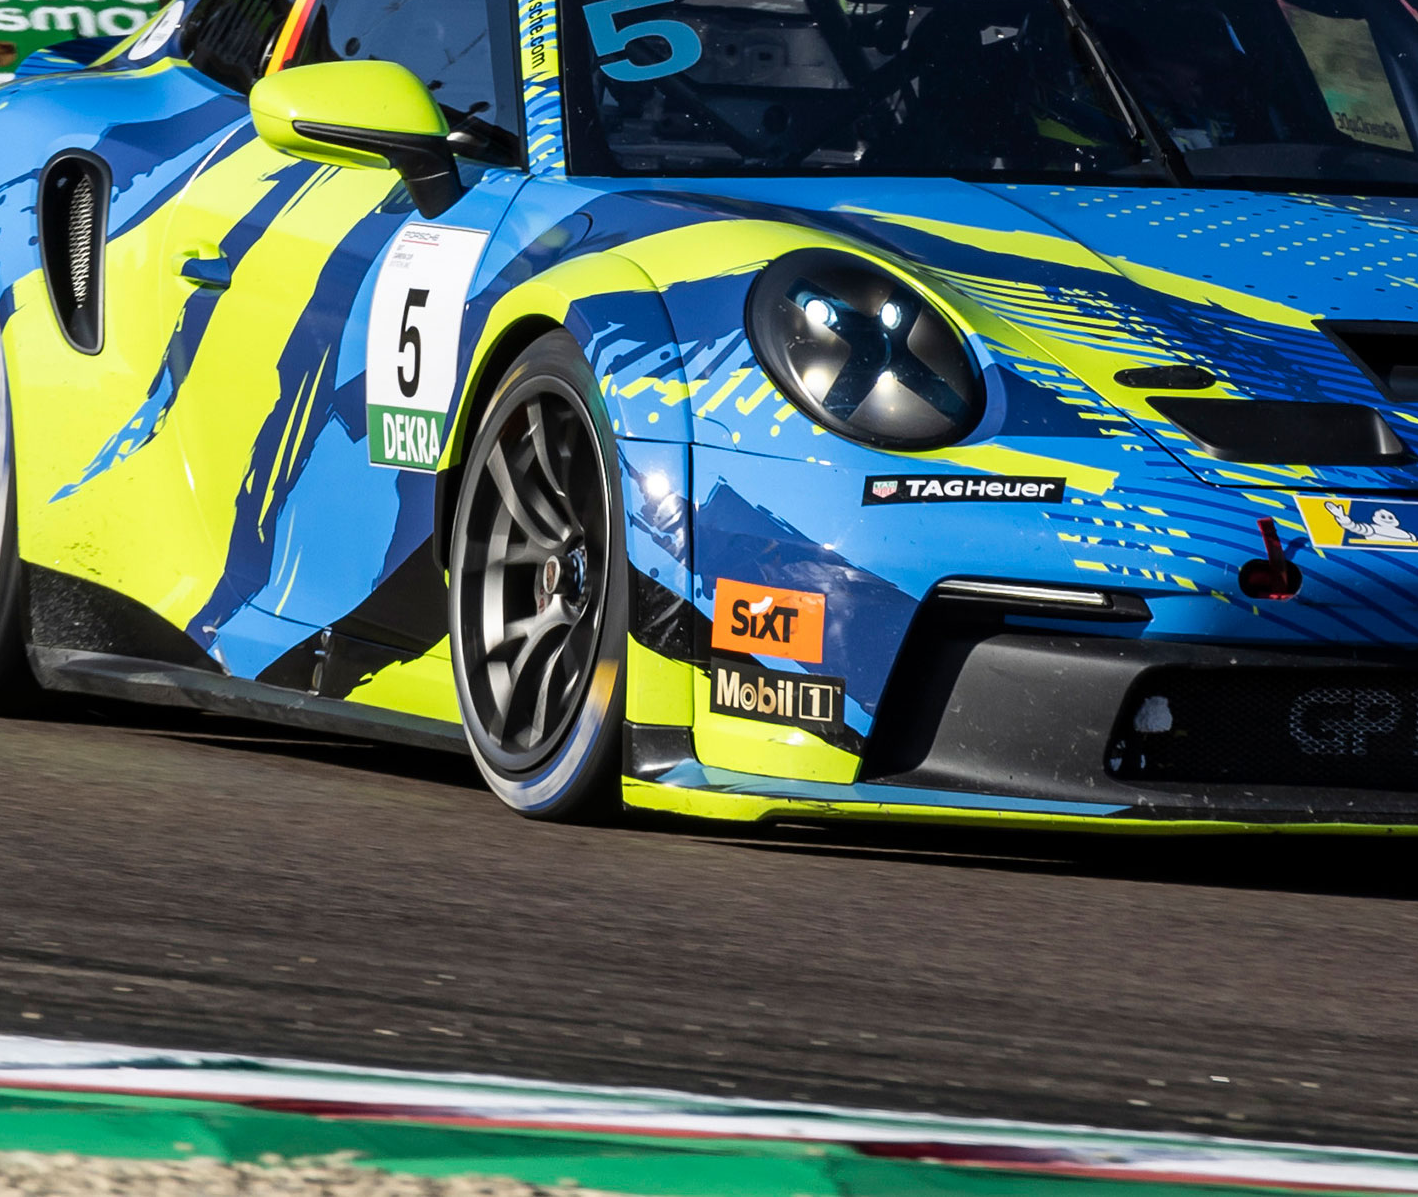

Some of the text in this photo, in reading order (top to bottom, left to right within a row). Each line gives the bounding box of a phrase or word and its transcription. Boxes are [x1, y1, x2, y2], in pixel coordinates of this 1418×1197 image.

[397, 288, 430, 398] 5
[383, 412, 440, 465] DEKRA
[716, 668, 793, 718] Mobil
